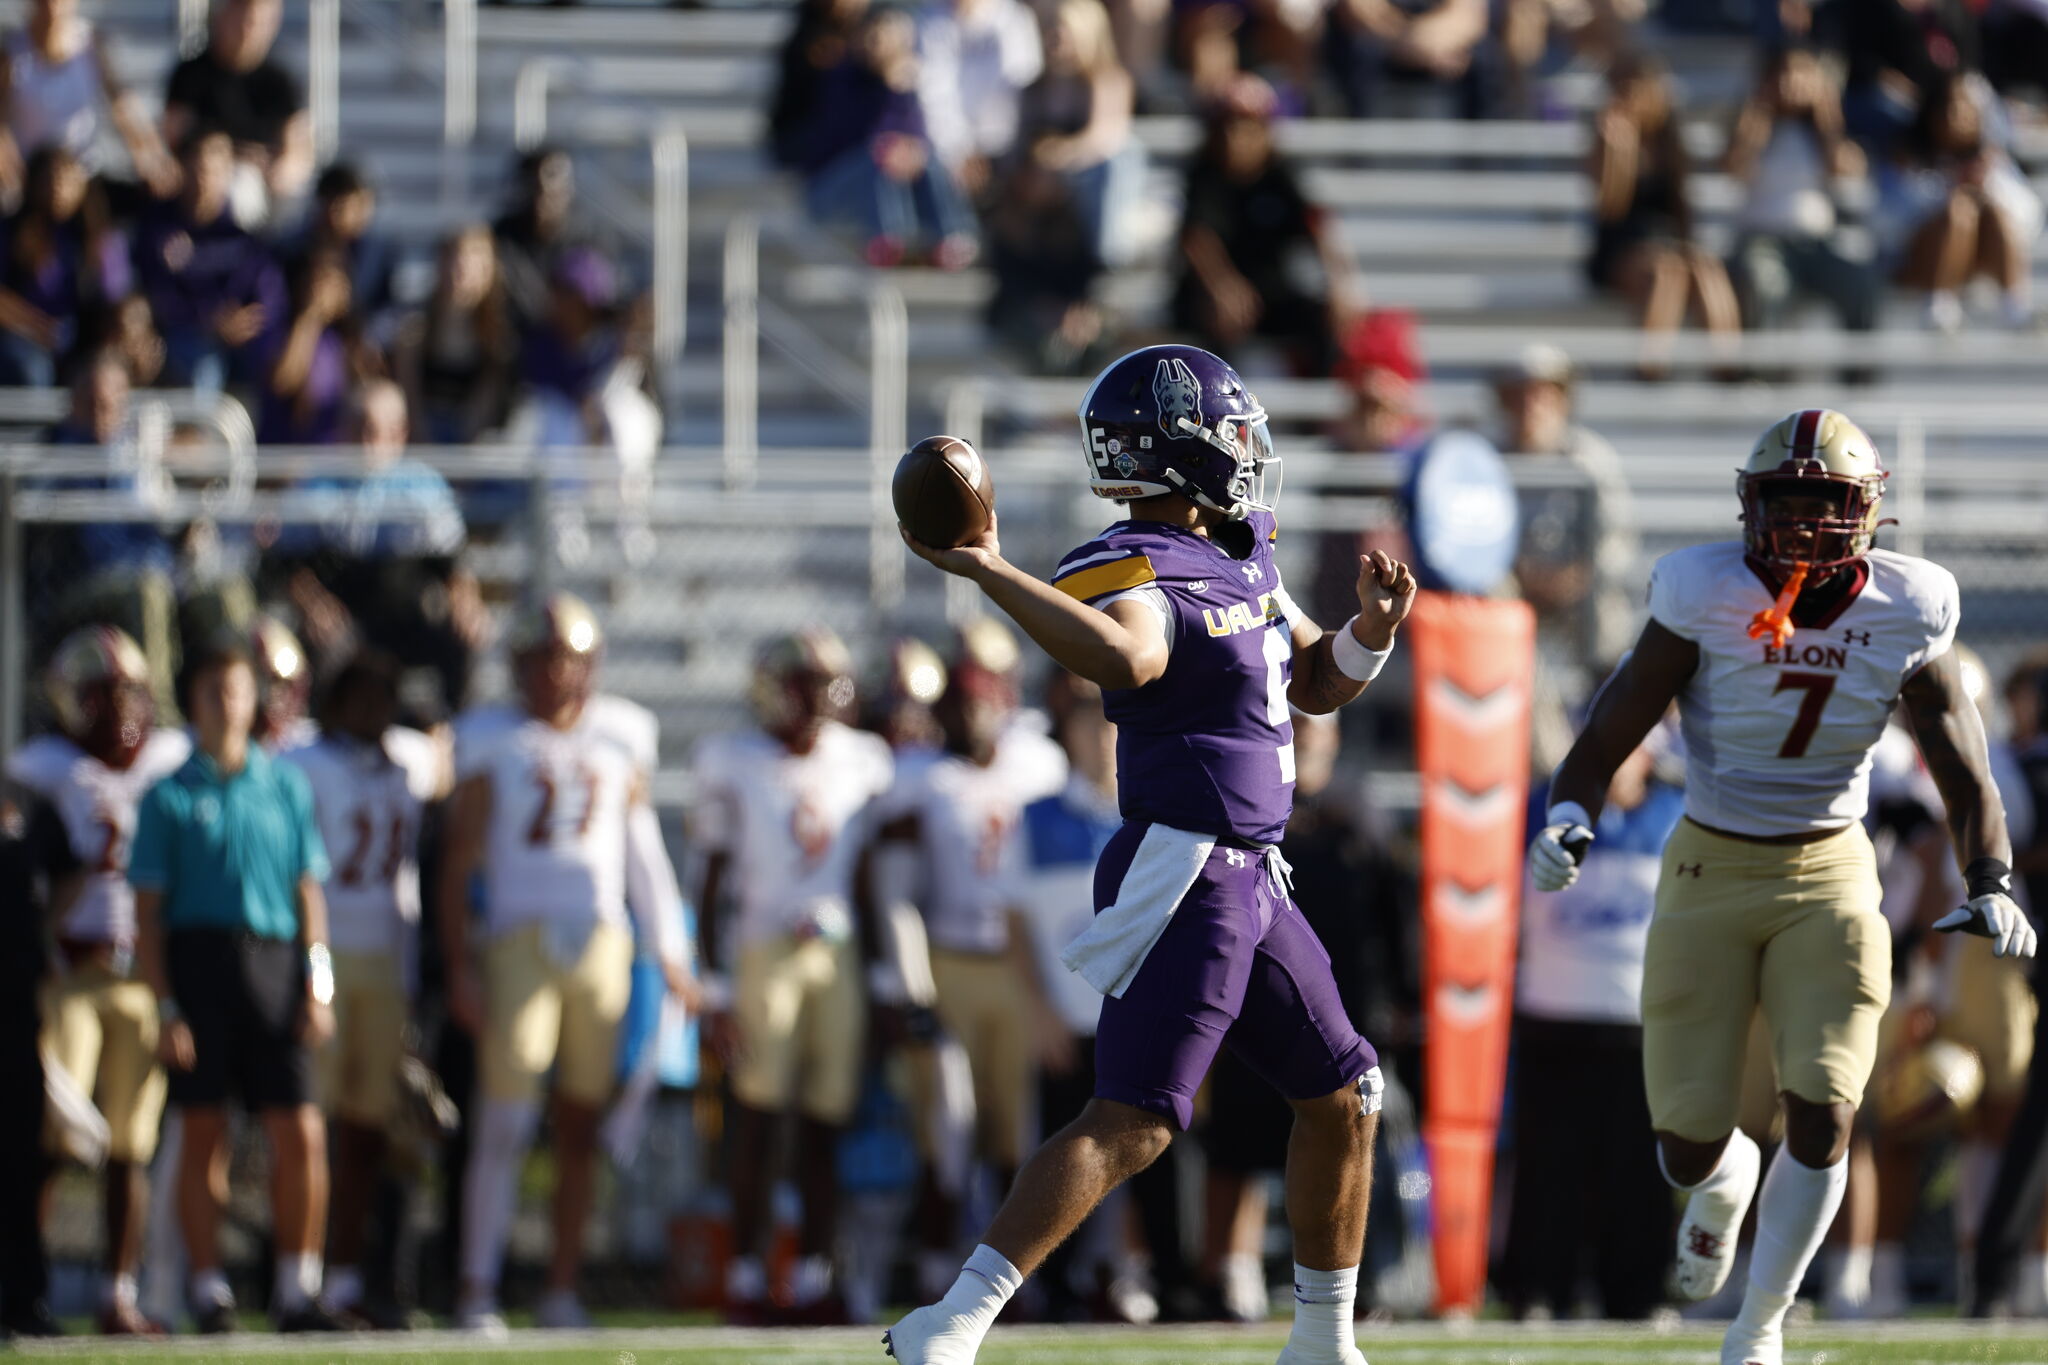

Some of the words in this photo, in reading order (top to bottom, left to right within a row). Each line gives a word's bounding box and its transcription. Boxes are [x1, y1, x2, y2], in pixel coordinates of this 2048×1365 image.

[1091, 427, 1110, 467] 5
[1099, 485, 1144, 497] DANES
[1187, 580, 1206, 591] CAA
[1763, 643, 1848, 669] ELON
[1771, 670, 1838, 759] 7
